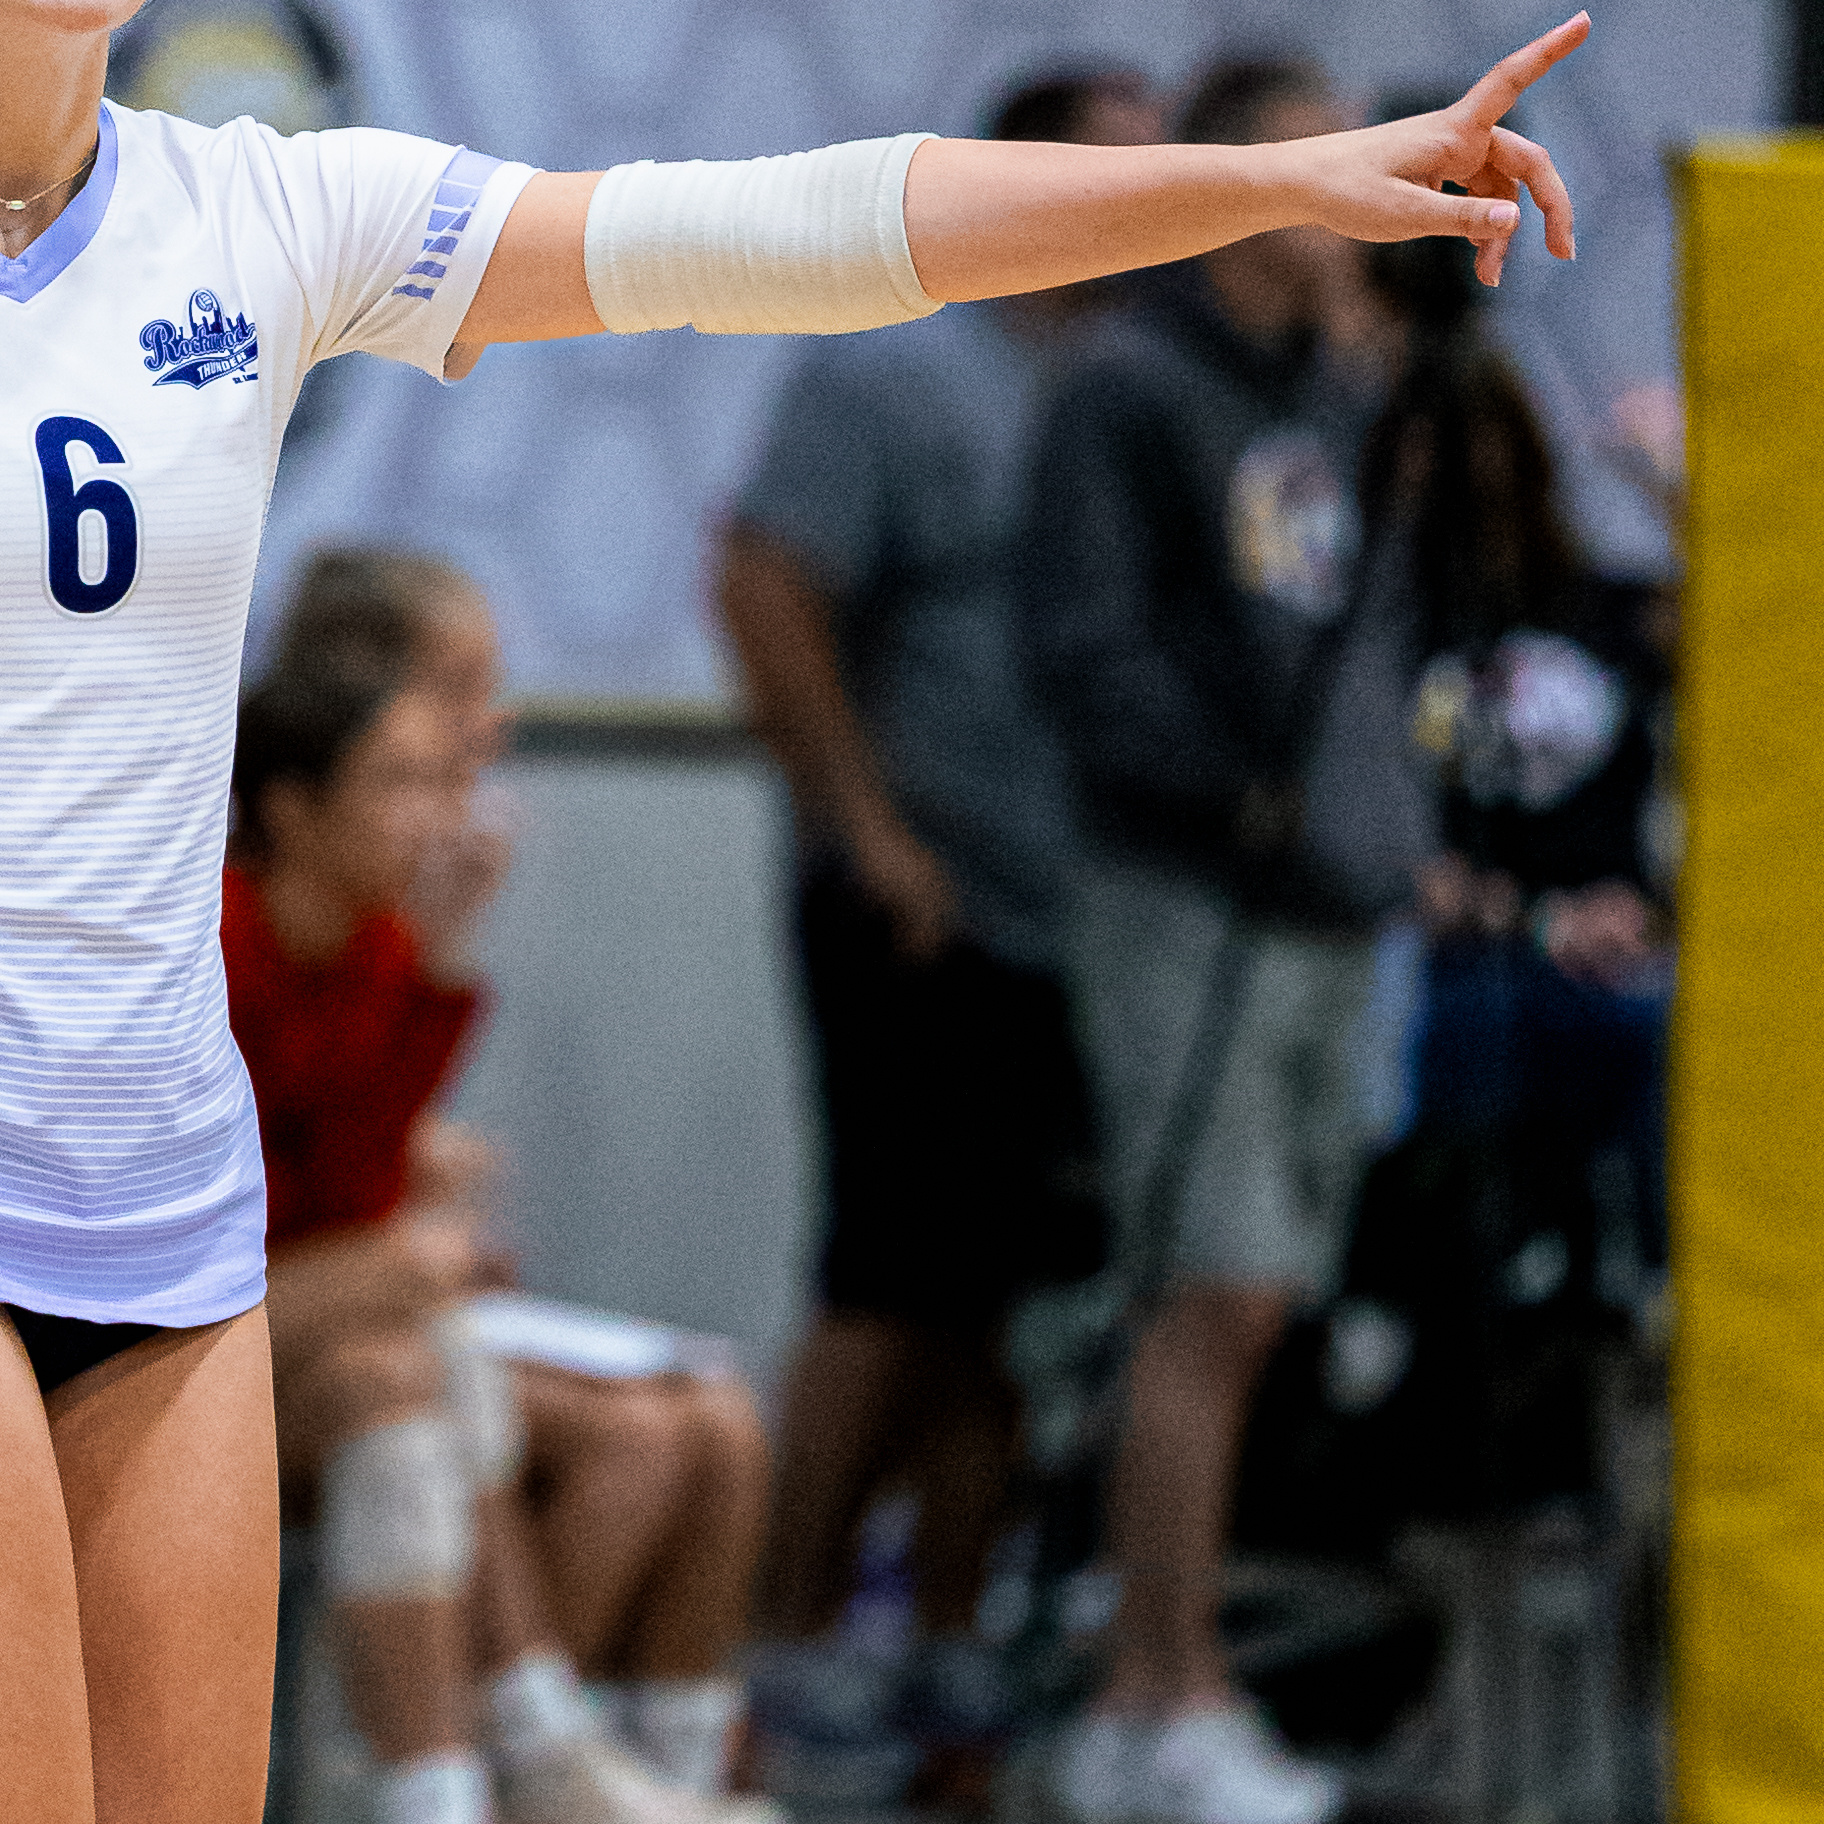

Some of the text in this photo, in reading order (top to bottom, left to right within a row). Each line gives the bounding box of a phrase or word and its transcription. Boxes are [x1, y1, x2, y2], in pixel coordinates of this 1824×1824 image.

[139, 318, 256, 371] Rockwood
[197, 351, 247, 381] THUNDER
[35, 416, 138, 614] 6
